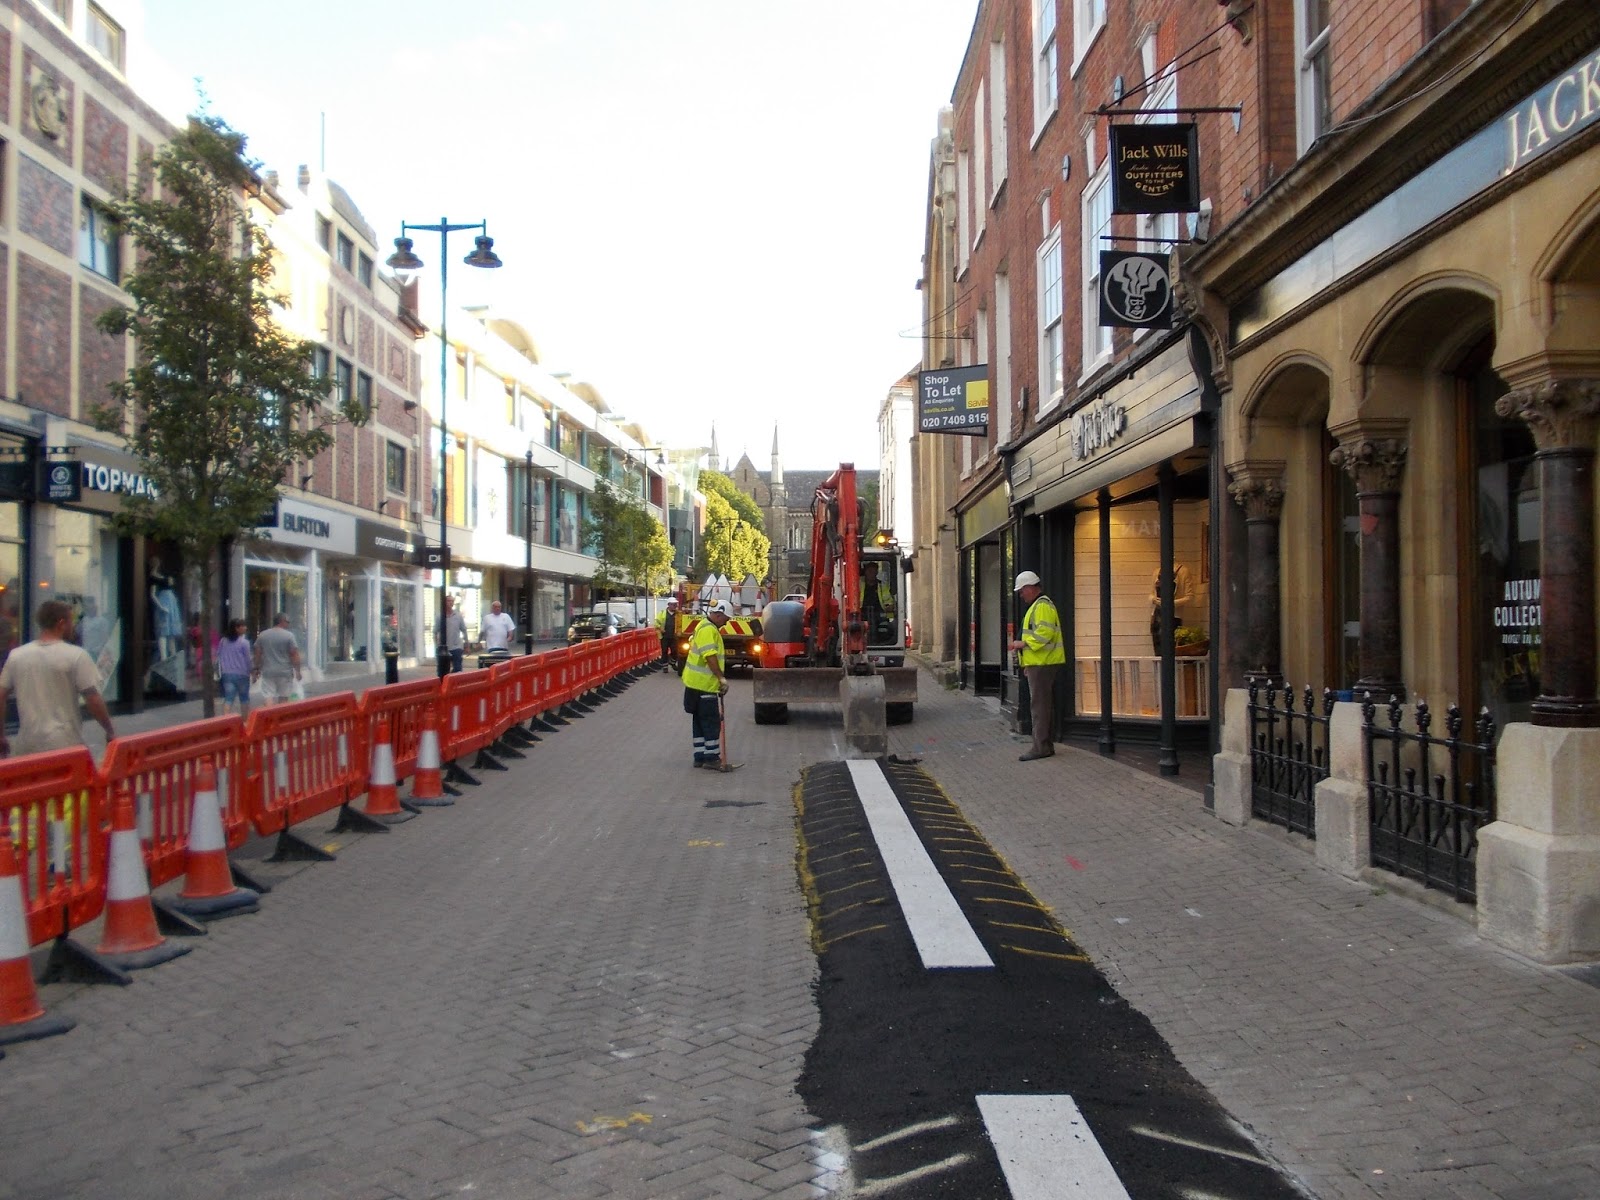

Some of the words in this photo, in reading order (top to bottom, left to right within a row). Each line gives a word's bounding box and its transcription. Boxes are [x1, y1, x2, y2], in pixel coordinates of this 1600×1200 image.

[1503, 54, 1600, 176] JACK
[1120, 146, 1149, 162] Jack
[1153, 144, 1188, 158] Wills
[1125, 171, 1184, 179] OUTFITTERS
[1135, 181, 1174, 192] GENTRY
[925, 376, 949, 385] Shop
[925, 387, 939, 398] To
[943, 385, 961, 396] Let
[923, 418, 940, 427] 020
[943, 415, 966, 425] 7409
[84, 462, 158, 500] TOPMAN
[283, 512, 330, 538] BURTON
[1504, 579, 1541, 600] AUTUM
[1494, 605, 1541, 626] COLLECT
[1502, 634, 1520, 644] now
[1522, 630, 1532, 645] in
